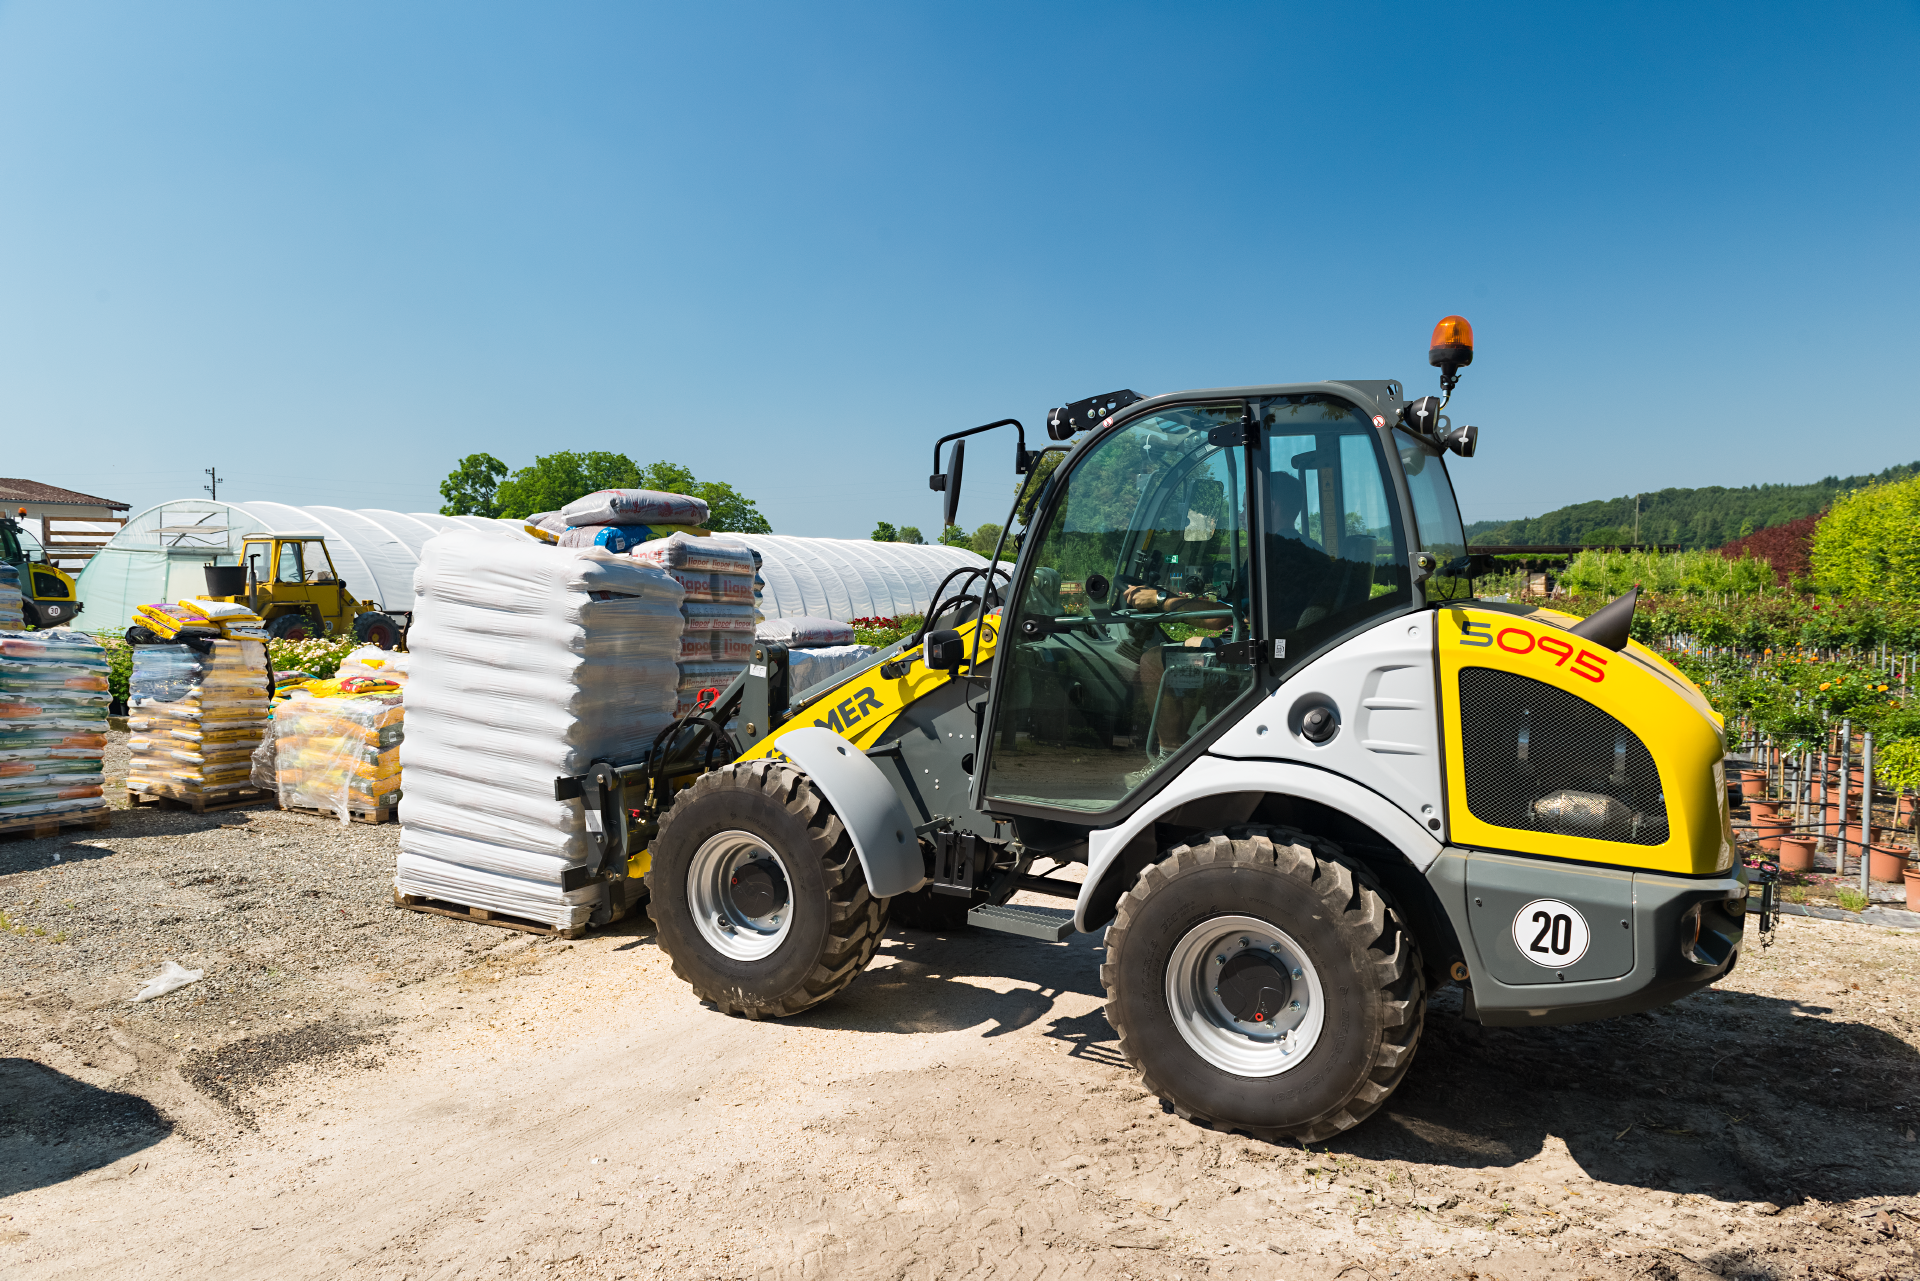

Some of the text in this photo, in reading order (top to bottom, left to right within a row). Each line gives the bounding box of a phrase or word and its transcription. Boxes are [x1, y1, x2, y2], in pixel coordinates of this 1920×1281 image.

[50, 607, 59, 615] 30
[1459, 620, 1608, 683] 5095
[813, 687, 884, 734] MER
[1530, 910, 1573, 955] 20
